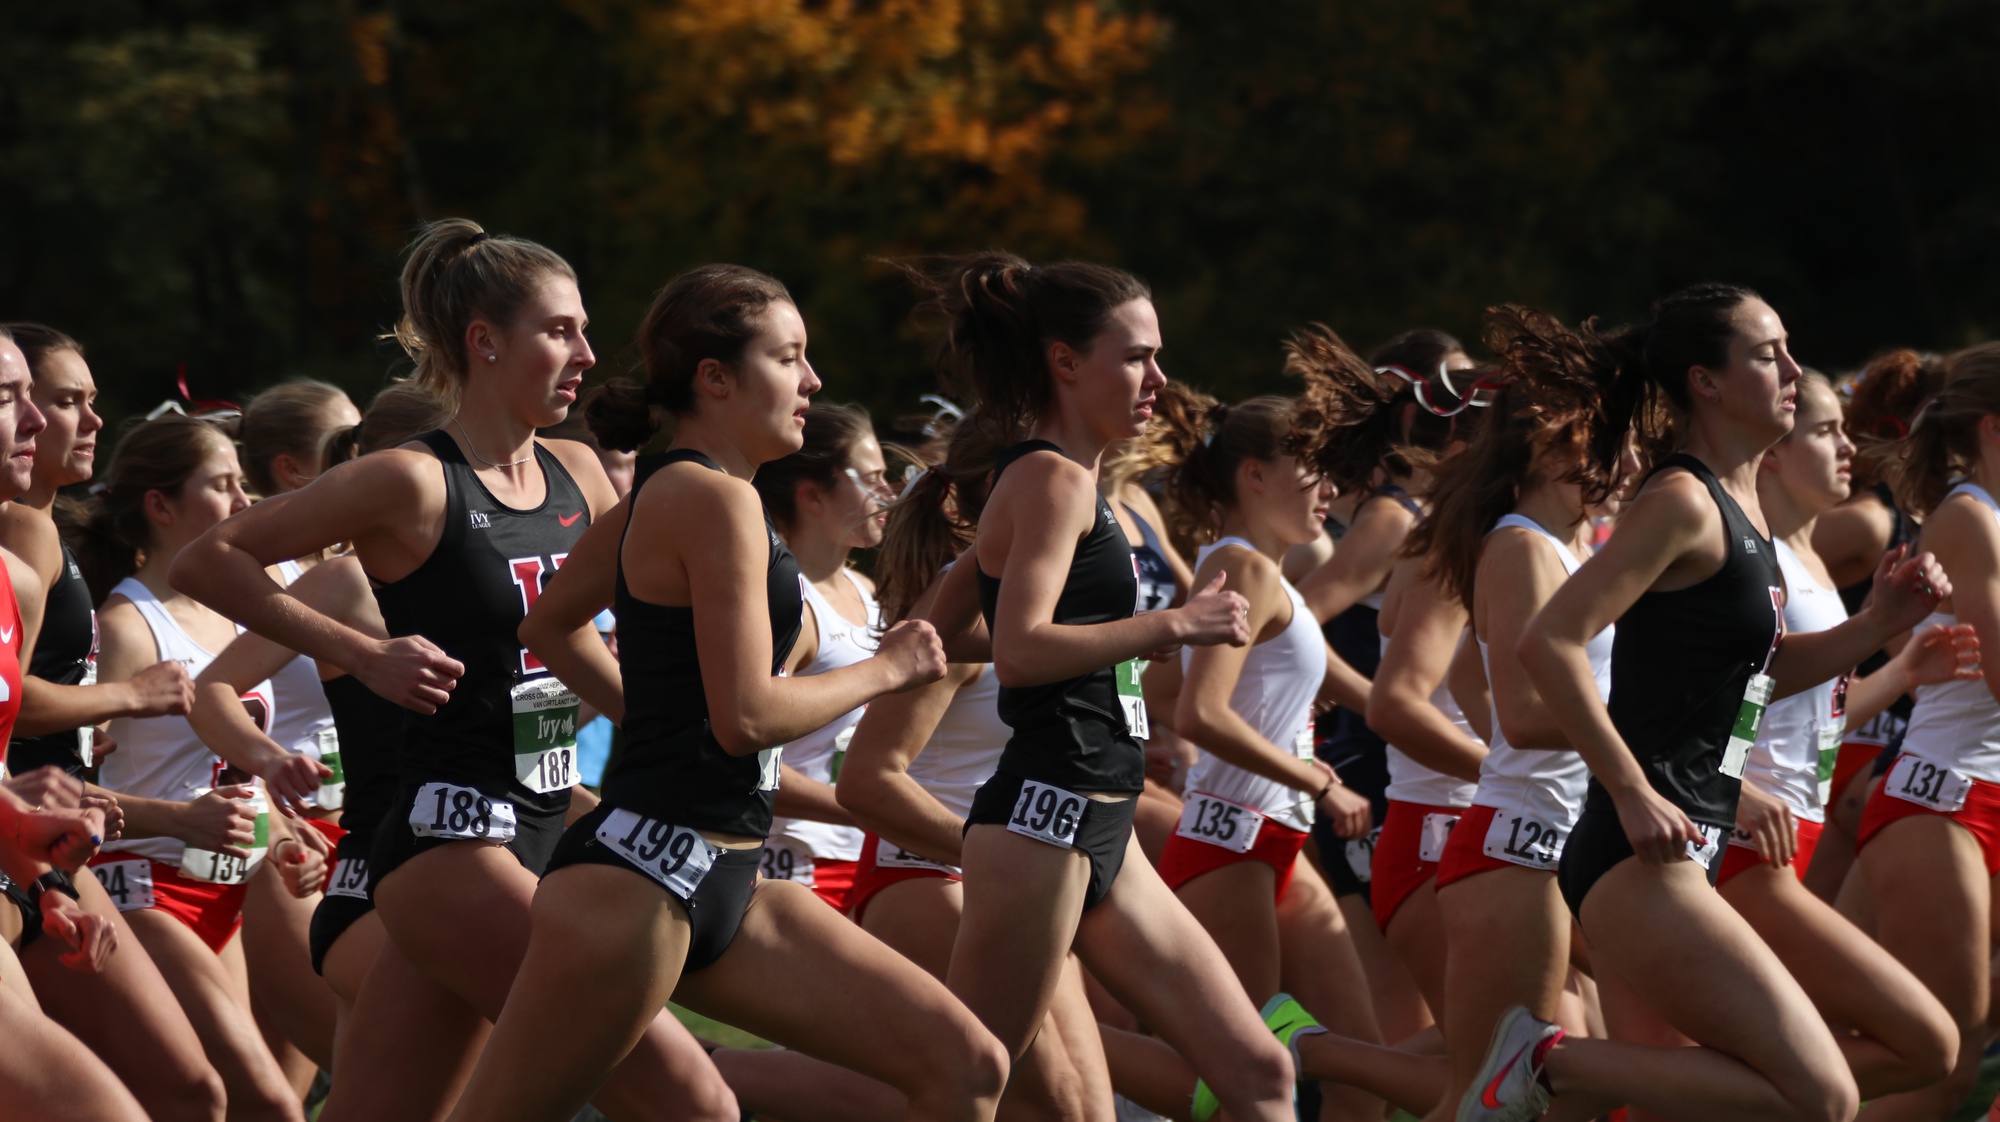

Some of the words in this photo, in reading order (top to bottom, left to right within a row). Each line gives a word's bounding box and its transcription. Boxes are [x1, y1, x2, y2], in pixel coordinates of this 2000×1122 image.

[471, 513, 488, 524] IVY
[515, 692, 536, 701] CROSS
[537, 691, 558, 699] COUNTRY
[543, 698, 570, 707] CORTLANDT
[538, 715, 561, 744] Ivy
[538, 749, 571, 789] 188
[1901, 761, 1948, 804] 131
[430, 787, 493, 838] 188
[1012, 785, 1080, 839] 196
[1191, 799, 1242, 841] 135
[618, 815, 695, 876] 199
[1503, 816, 1558, 863] 129
[210, 852, 248, 882] 134
